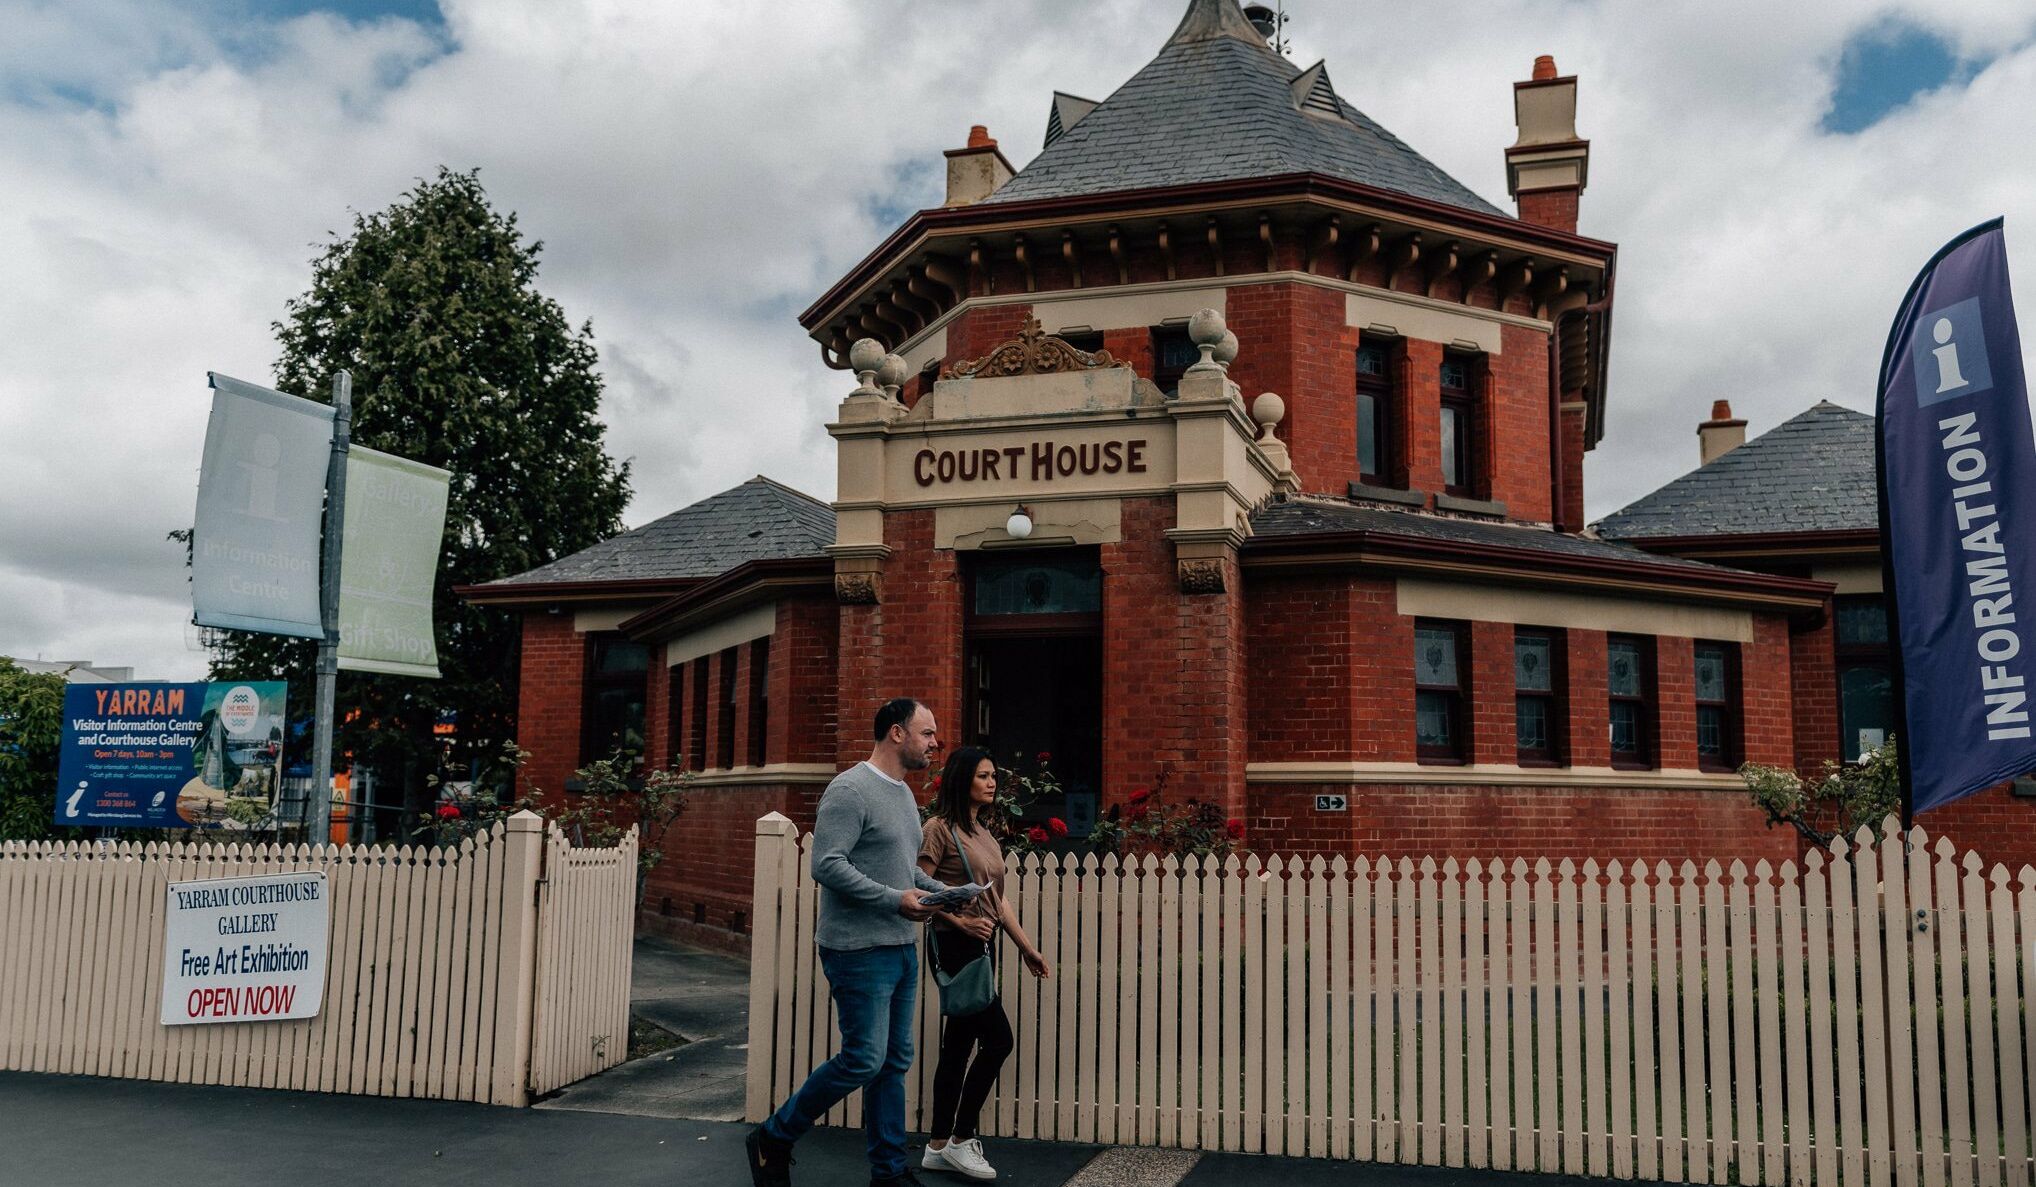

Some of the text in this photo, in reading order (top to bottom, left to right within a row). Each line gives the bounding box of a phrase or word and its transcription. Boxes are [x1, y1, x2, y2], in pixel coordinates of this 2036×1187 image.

[364, 475, 431, 513] Gallery
[203, 539, 311, 573] Information
[229, 575, 289, 600] Centre
[1938, 411, 2032, 741] INFORMATION
[340, 622, 433, 660] Gift Shop
[95, 688, 185, 716] YARRAM
[73, 719, 203, 732] Visitor Information Centre
[78, 734, 197, 748] and Courthouse Gallery
[94, 750, 112, 759] Open
[136, 750, 154, 758] 10am
[159, 751, 174, 759] 3pm
[177, 881, 320, 910] YARRAM COURTHOUSE
[218, 912, 279, 936] GALLERY
[181, 942, 309, 977] Free Art Exhibition
[187, 985, 296, 1018] OPEN NOW
